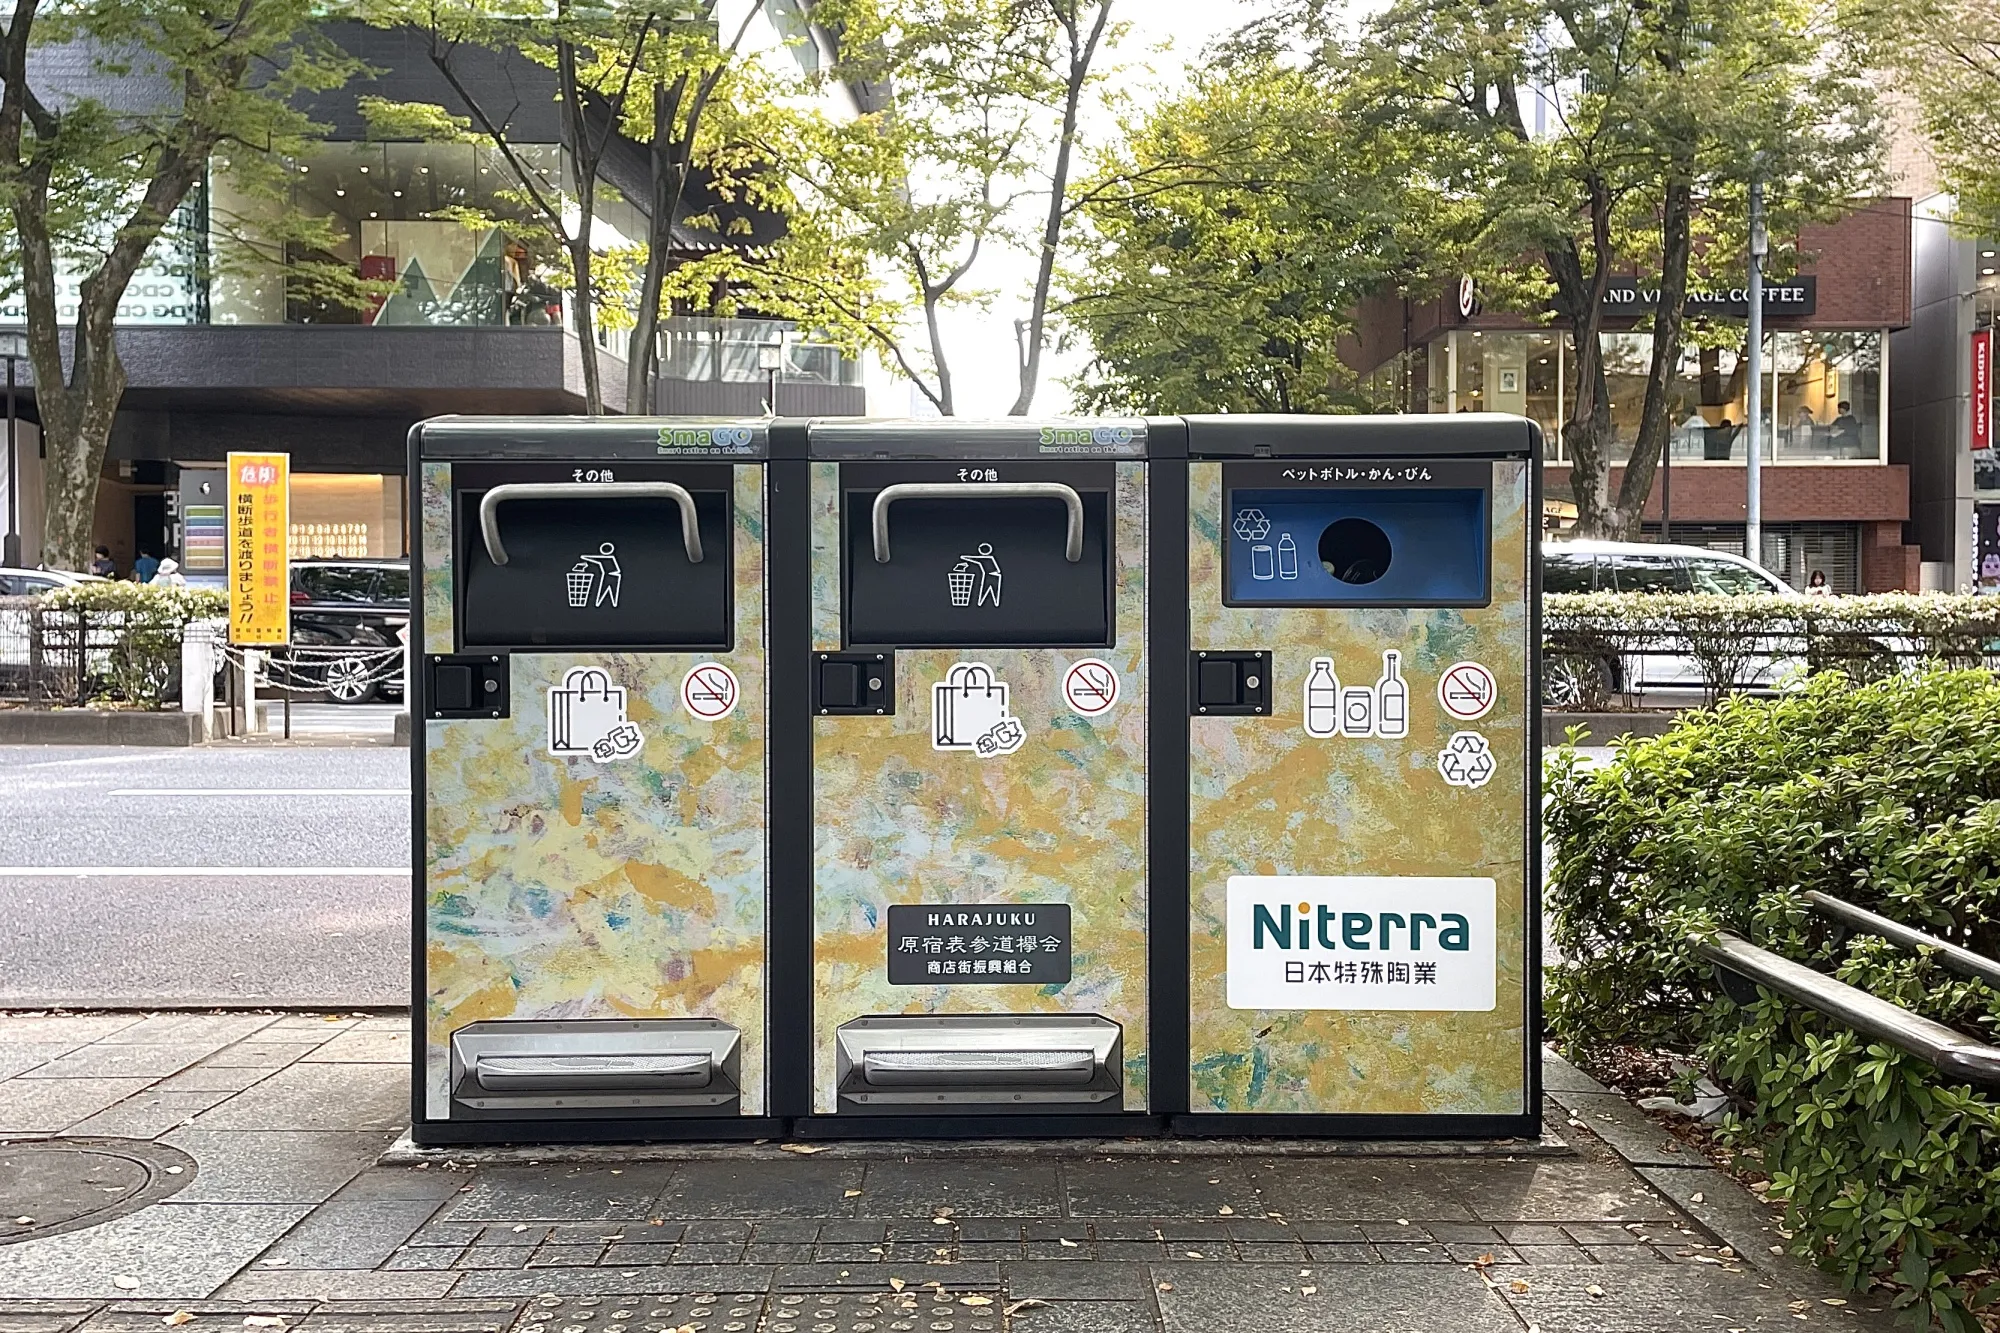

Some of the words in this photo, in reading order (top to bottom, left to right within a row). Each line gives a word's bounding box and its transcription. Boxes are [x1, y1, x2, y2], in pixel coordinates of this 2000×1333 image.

[572, 469, 614, 483] その他
[957, 468, 998, 482] その他
[928, 913, 1036, 926] HARAJUKU
[1253, 902, 1470, 951] Niterra
[898, 934, 1062, 954] 原宿表参道欅会
[927, 959, 1033, 974] 商店街振興組合
[1285, 961, 1437, 984] 日本特殊陶業
